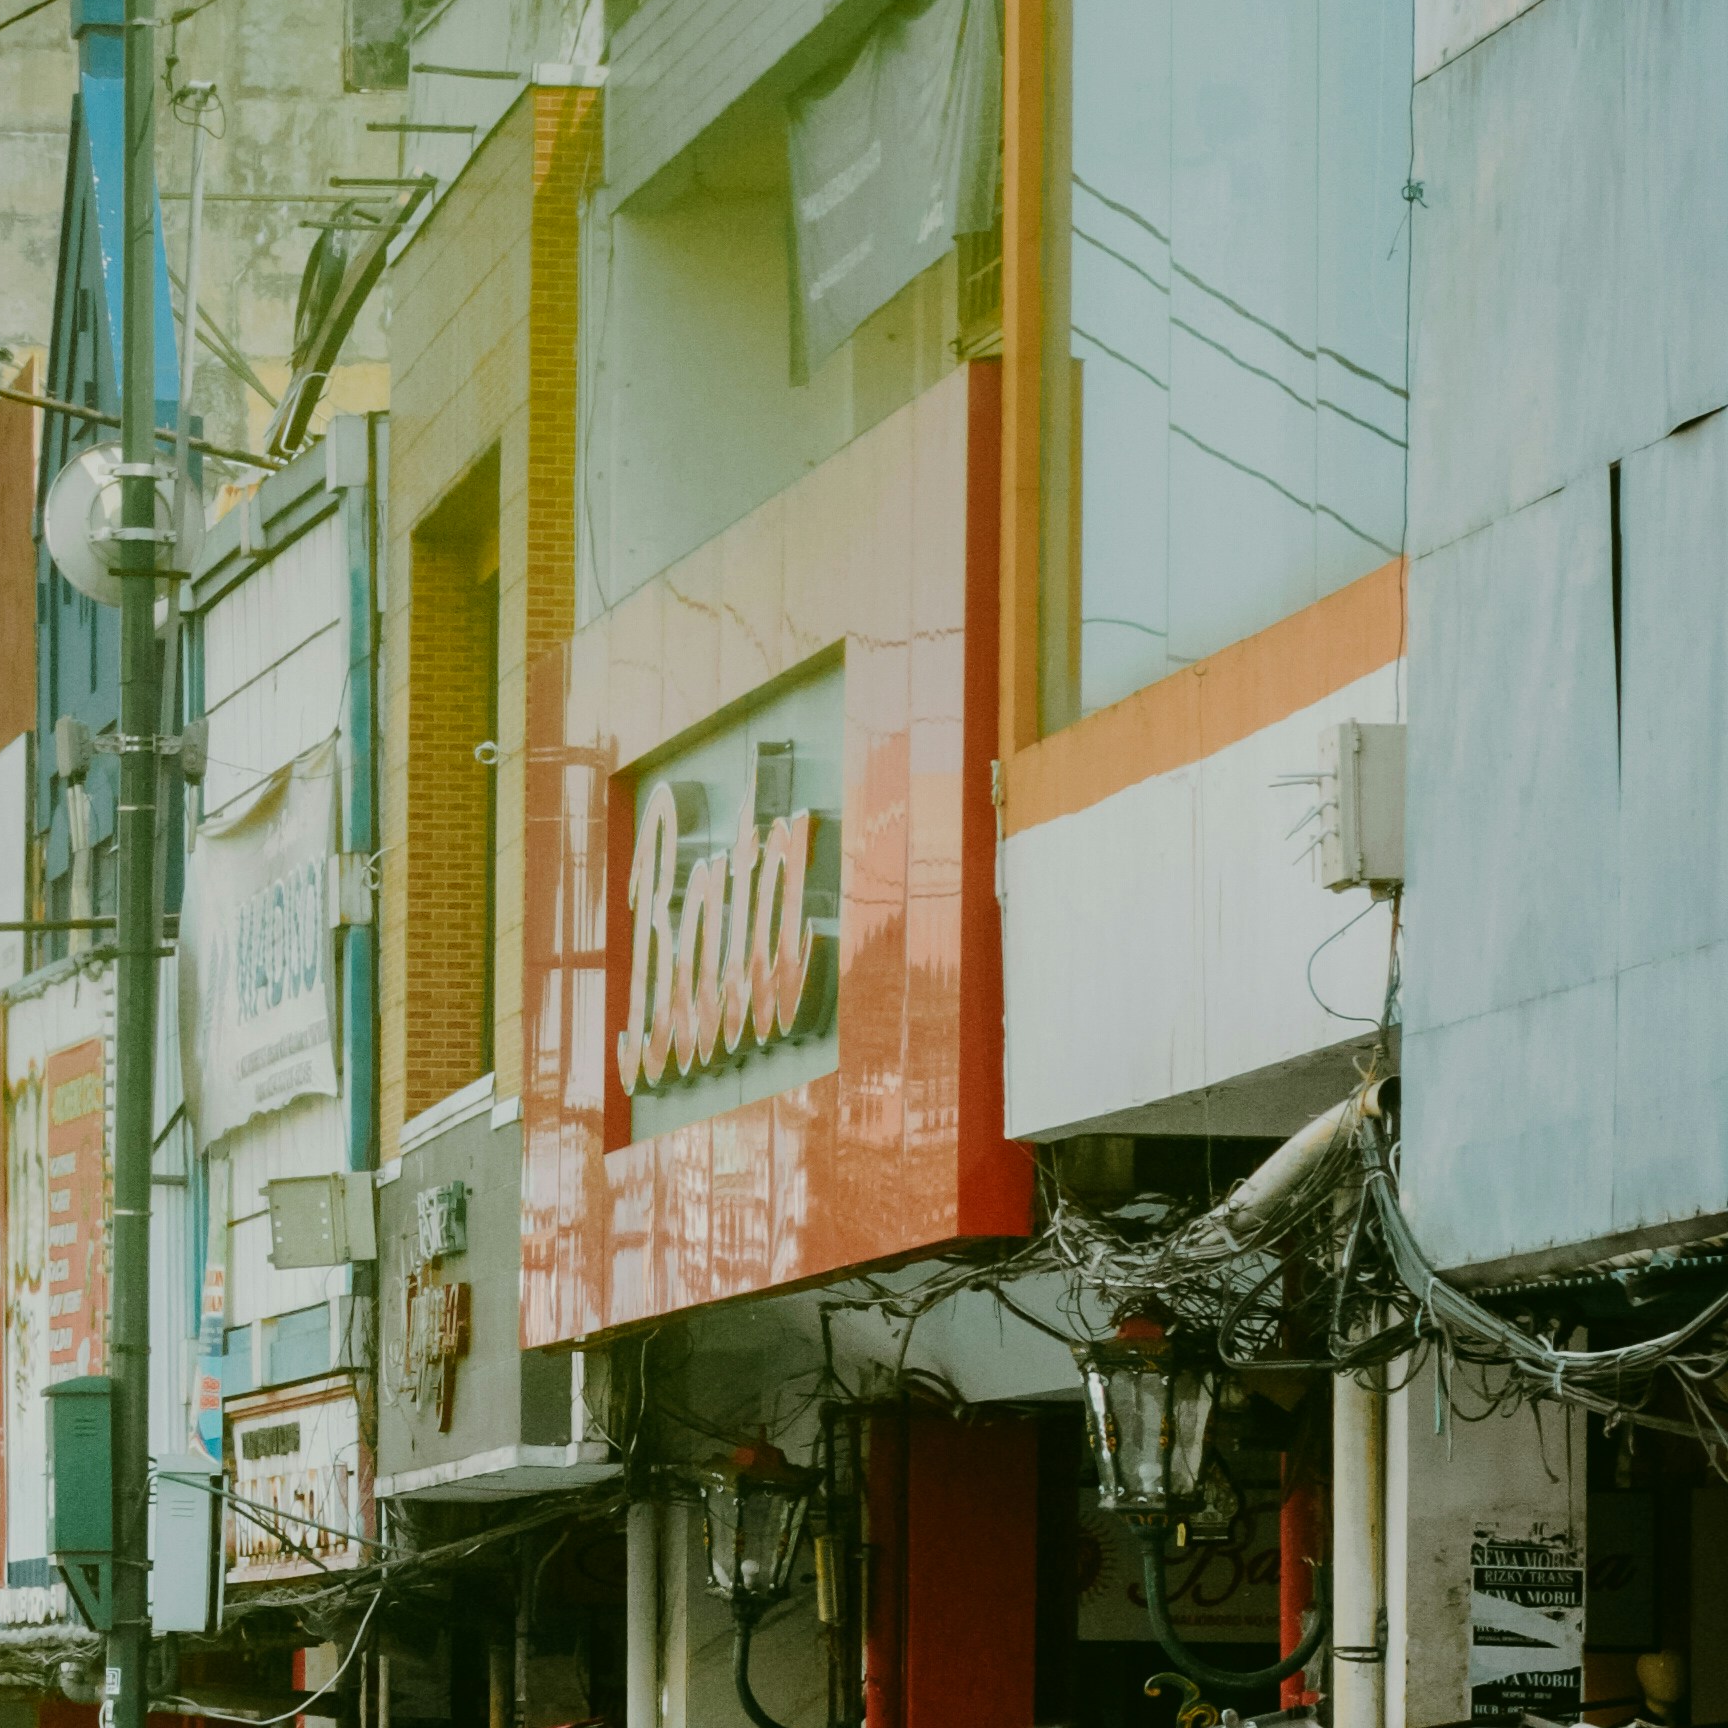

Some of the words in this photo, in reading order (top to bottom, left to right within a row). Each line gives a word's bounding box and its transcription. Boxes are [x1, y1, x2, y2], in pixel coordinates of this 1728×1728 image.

[617, 740, 814, 1096] Bata
[1524, 1551, 1577, 1568] MOBI
[1485, 1570, 1523, 1583] RIZKY
[1529, 1571, 1573, 1583] TRANS
[1481, 1589, 1522, 1604] EWA
[1527, 1591, 1581, 1605] MOBIL
[1525, 1673, 1580, 1688] MOBIL
